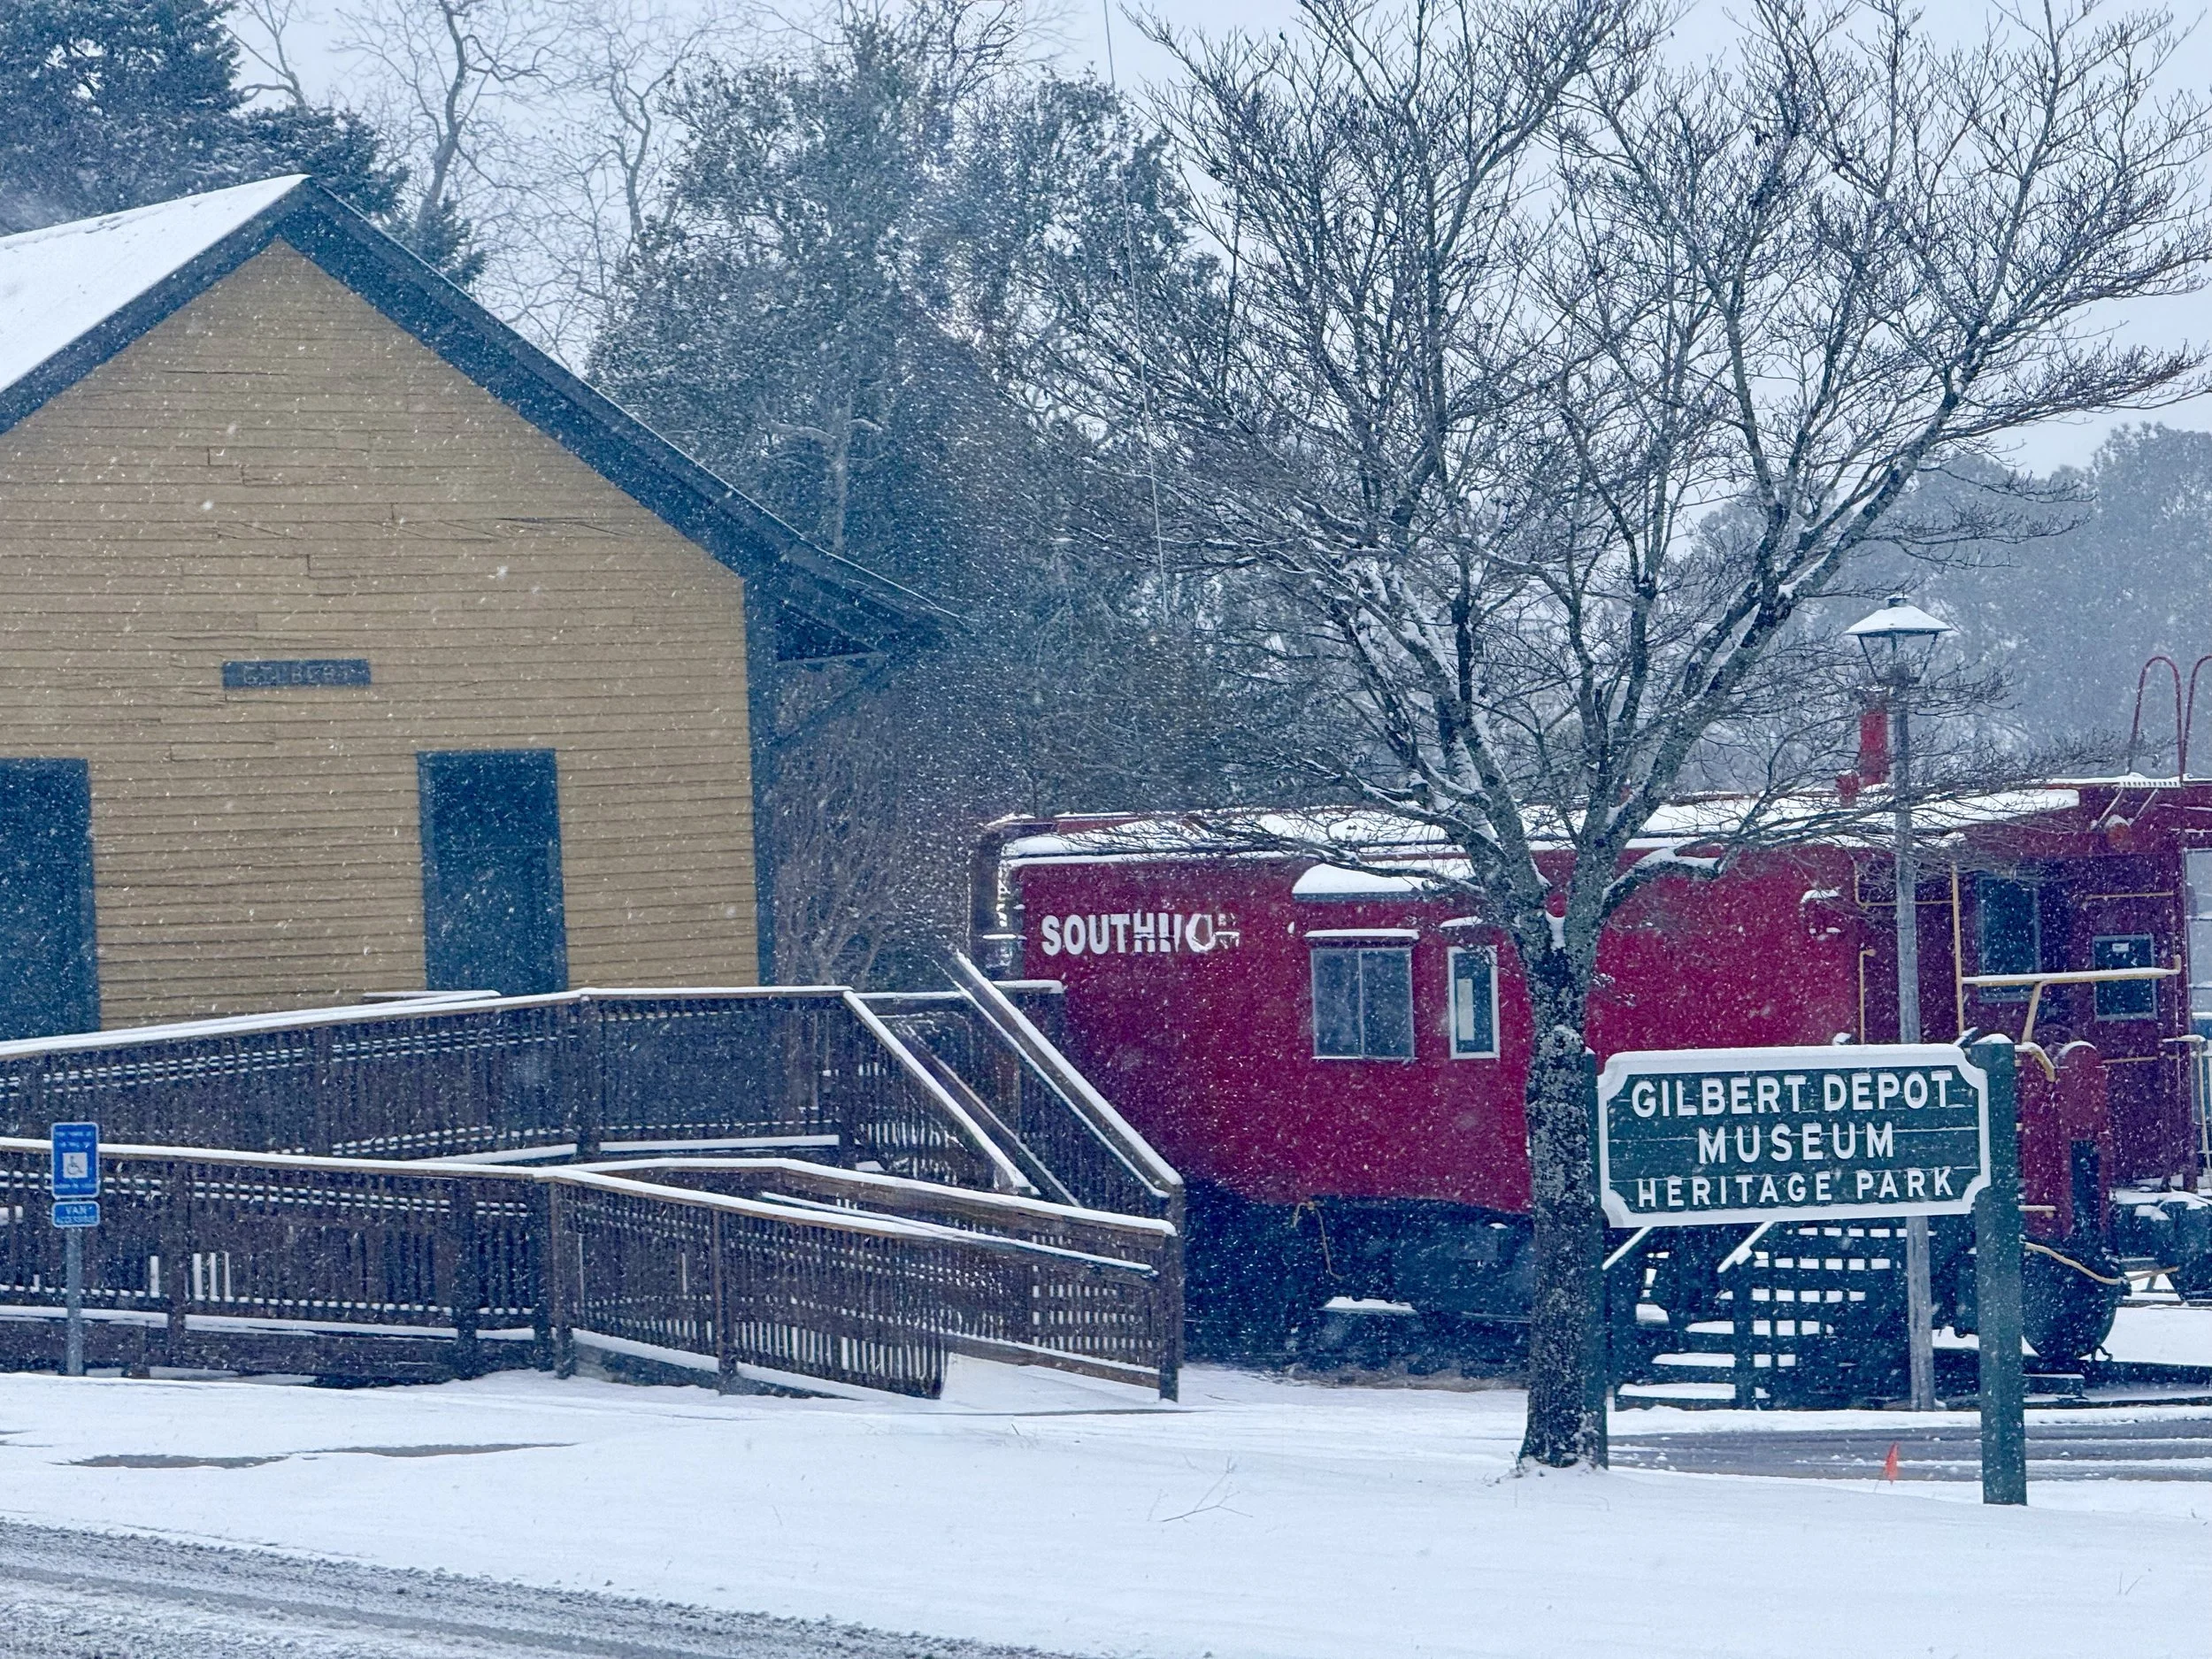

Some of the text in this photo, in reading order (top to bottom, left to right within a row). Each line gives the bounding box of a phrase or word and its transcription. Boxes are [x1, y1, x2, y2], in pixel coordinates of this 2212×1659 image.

[1631, 1070, 1953, 1118] GILBERT DEPOT
[1698, 1122, 1893, 1164] MUSEUM
[1638, 1166, 1953, 1208] HERITAGE PARK
